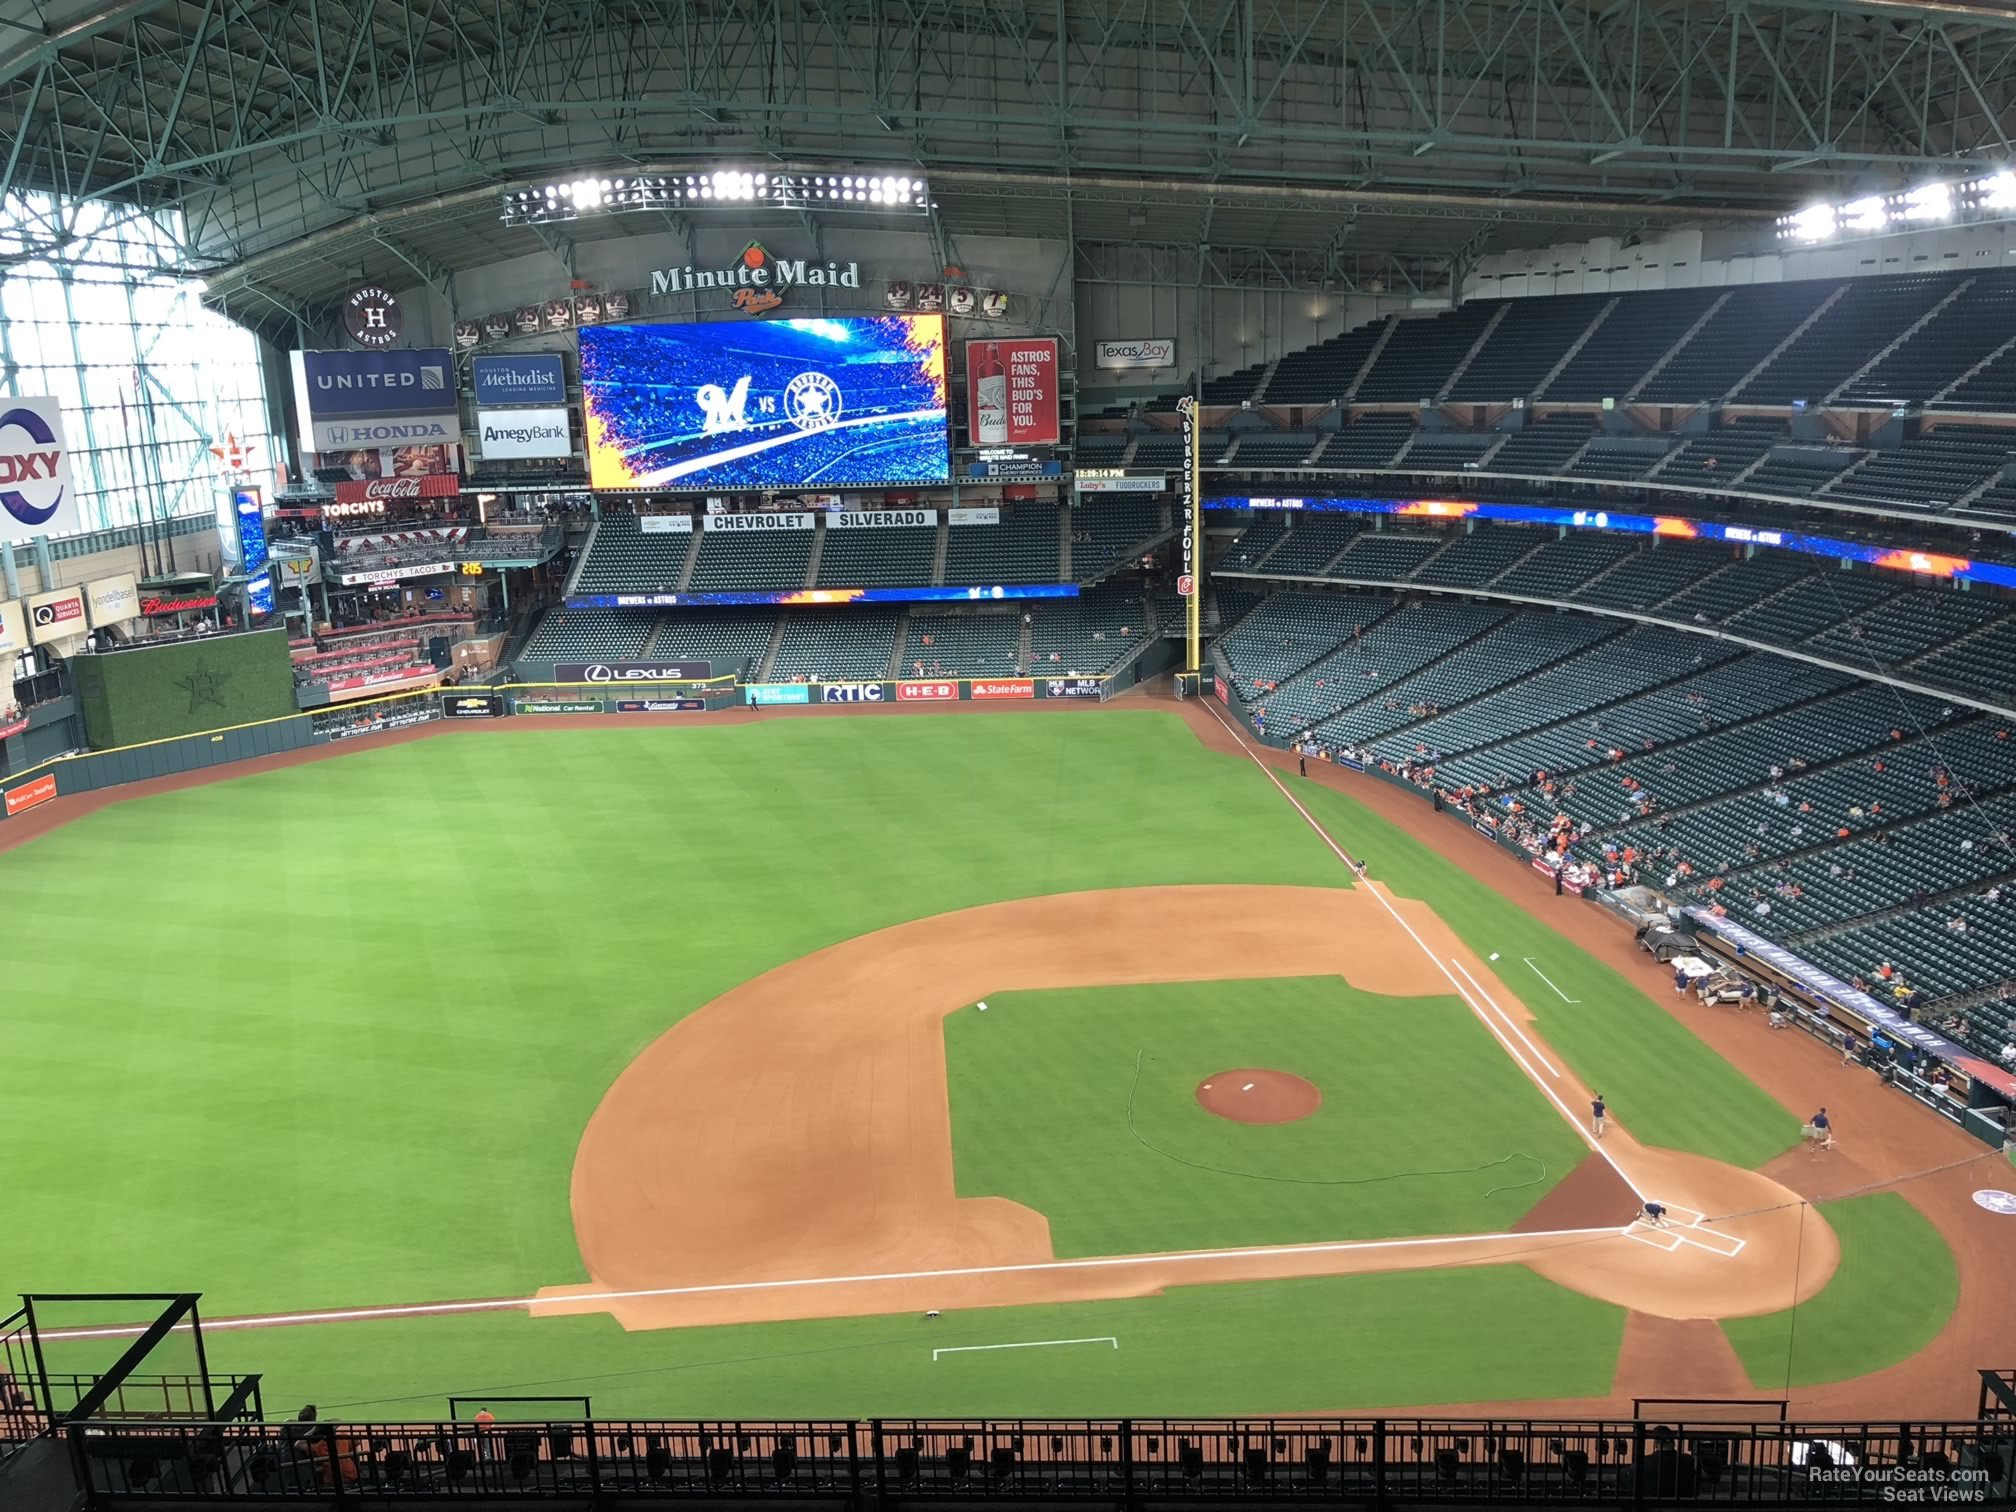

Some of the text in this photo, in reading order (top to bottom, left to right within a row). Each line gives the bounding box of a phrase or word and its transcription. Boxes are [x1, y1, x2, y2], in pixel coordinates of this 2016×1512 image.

[650, 260, 860, 295] Minute Maid
[351, 289, 395, 306] HOUSTON
[733, 288, 782, 308] Park
[919, 284, 946, 300] 24
[956, 287, 968, 303] 5
[989, 291, 1000, 307] 7
[364, 308, 387, 328] H
[356, 329, 397, 345] ASTROS
[1011, 350, 1051, 362] ASTROS
[1101, 343, 1170, 360] Texas Bay
[1011, 364, 1040, 376] FANS,
[317, 372, 415, 390] UNITED
[482, 370, 556, 387] Methodist
[1011, 377, 1035, 388] THIS
[1012, 389, 1043, 401] BUD'S
[1012, 402, 1032, 413] FOR
[1012, 415, 1036, 426] YOU.
[352, 424, 447, 441] HONDA
[484, 426, 565, 443] AmegyBank
[999, 463, 1043, 471] CHAMPION
[1109, 469, 1124, 477] PM
[1116, 481, 1160, 489] FUDDRUCKERS
[323, 500, 384, 518] TORCHYS
[714, 515, 805, 529] CHEVROLET
[839, 511, 925, 526] SILVERADO
[1182, 524, 1192, 574] FOUL
[363, 565, 437, 581] TORCHYS TACOS
[56, 601, 79, 612] QUANTA
[141, 595, 218, 615] Budweiser
[56, 608, 80, 619] SERVICES
[362, 673, 404, 685] Budweiser
[613, 668, 682, 680] LEXUS
[823, 684, 881, 701] RTIC
[1066, 686, 1100, 695] NETWOR
[533, 704, 561, 712] National
[1892, 1021, 1947, 1047] HOME
